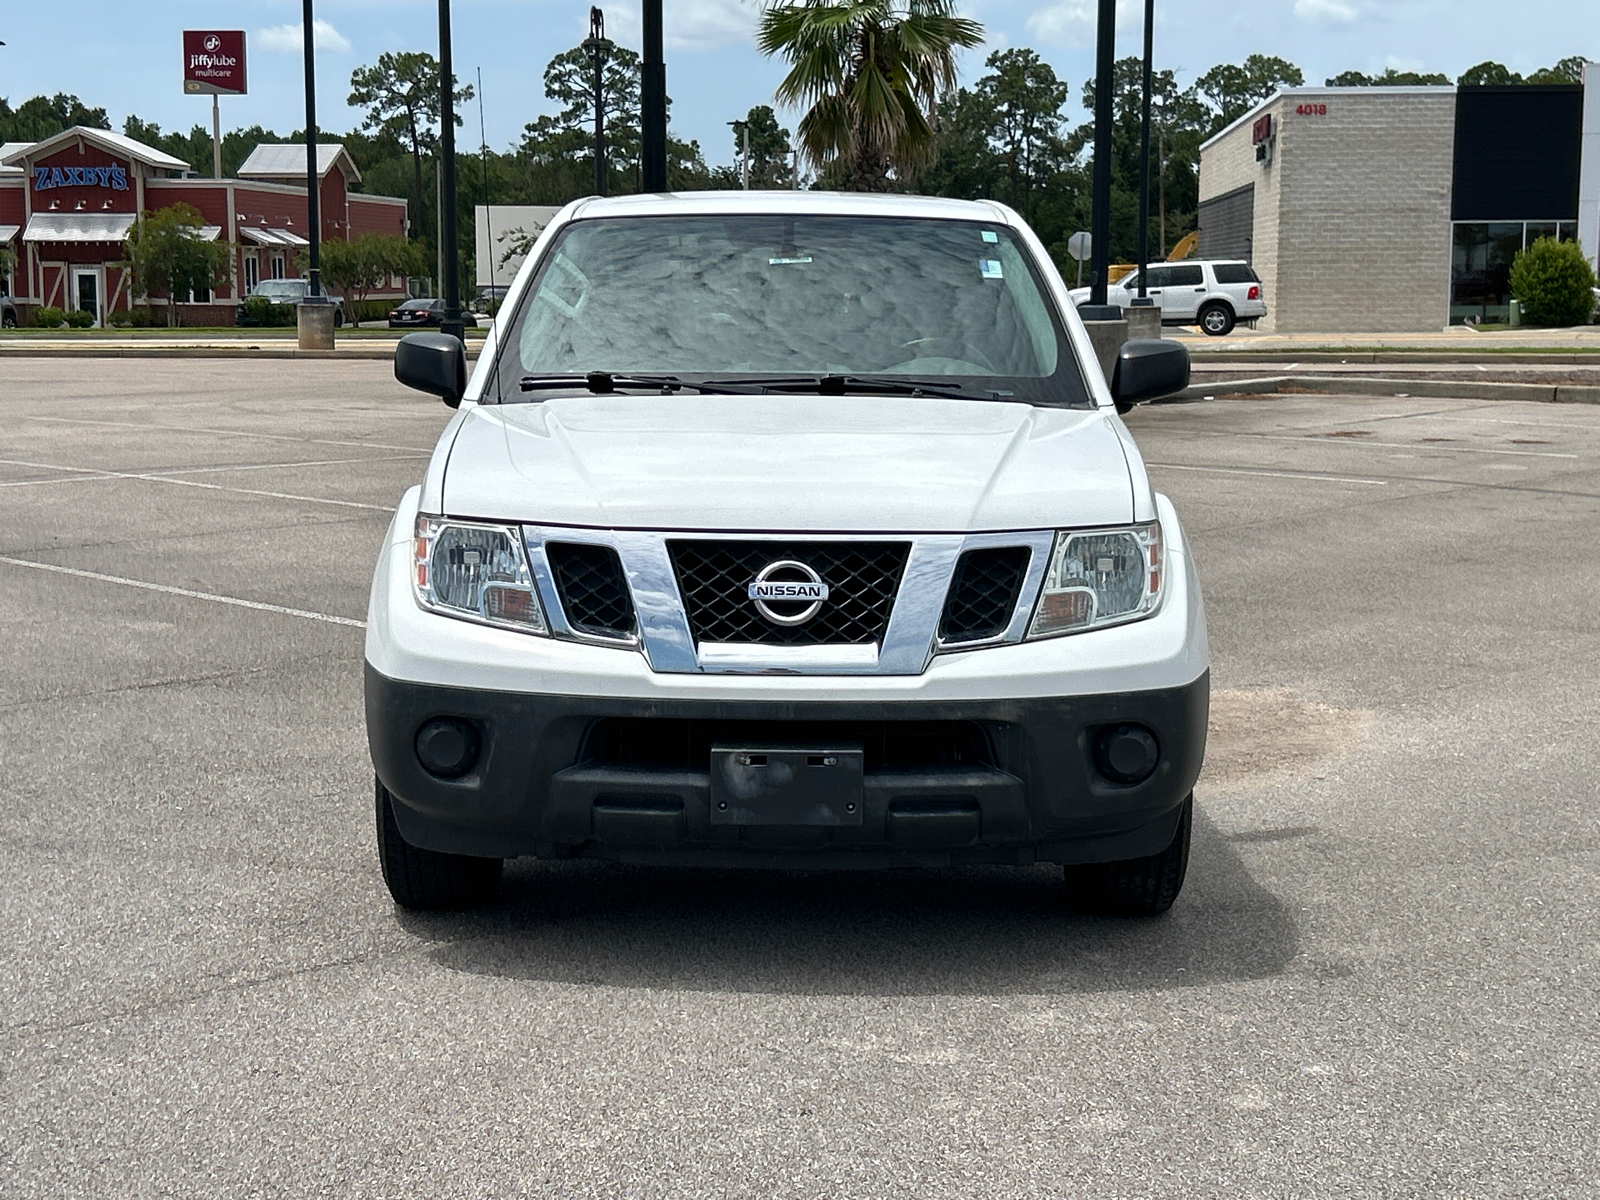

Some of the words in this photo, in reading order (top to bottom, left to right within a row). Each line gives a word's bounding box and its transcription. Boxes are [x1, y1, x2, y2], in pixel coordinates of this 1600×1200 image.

[195, 69, 232, 77] multicare
[1296, 104, 1327, 115] 4018
[34, 162, 127, 191] ZAXBY'S
[756, 585, 821, 597] NISSAN
